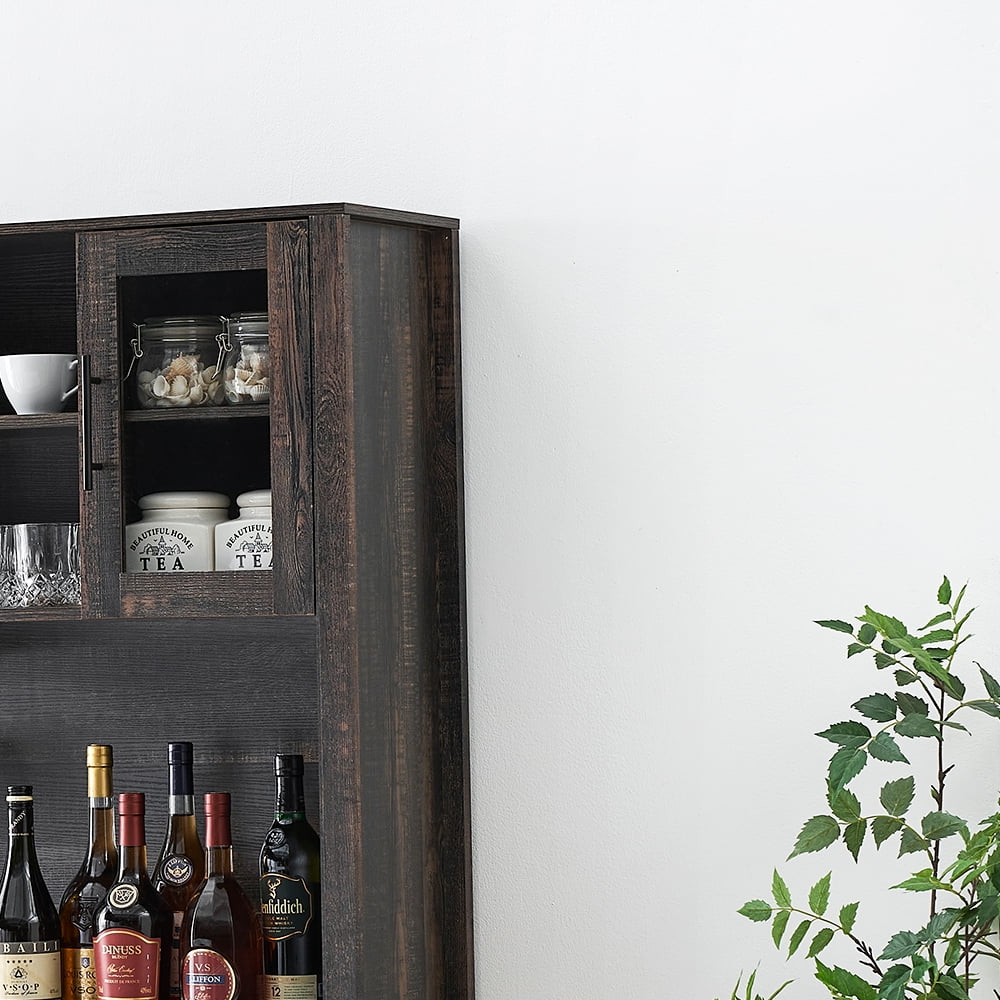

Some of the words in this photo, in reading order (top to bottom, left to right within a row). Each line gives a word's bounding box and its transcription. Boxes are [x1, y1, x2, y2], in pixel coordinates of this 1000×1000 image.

[130, 527, 170, 551] BEAUTIFUL
[170, 529, 195, 550] HOME
[226, 524, 267, 549] BEAUTIFUL
[139, 556, 185, 571] TEA
[271, 986, 281, 997] 12
